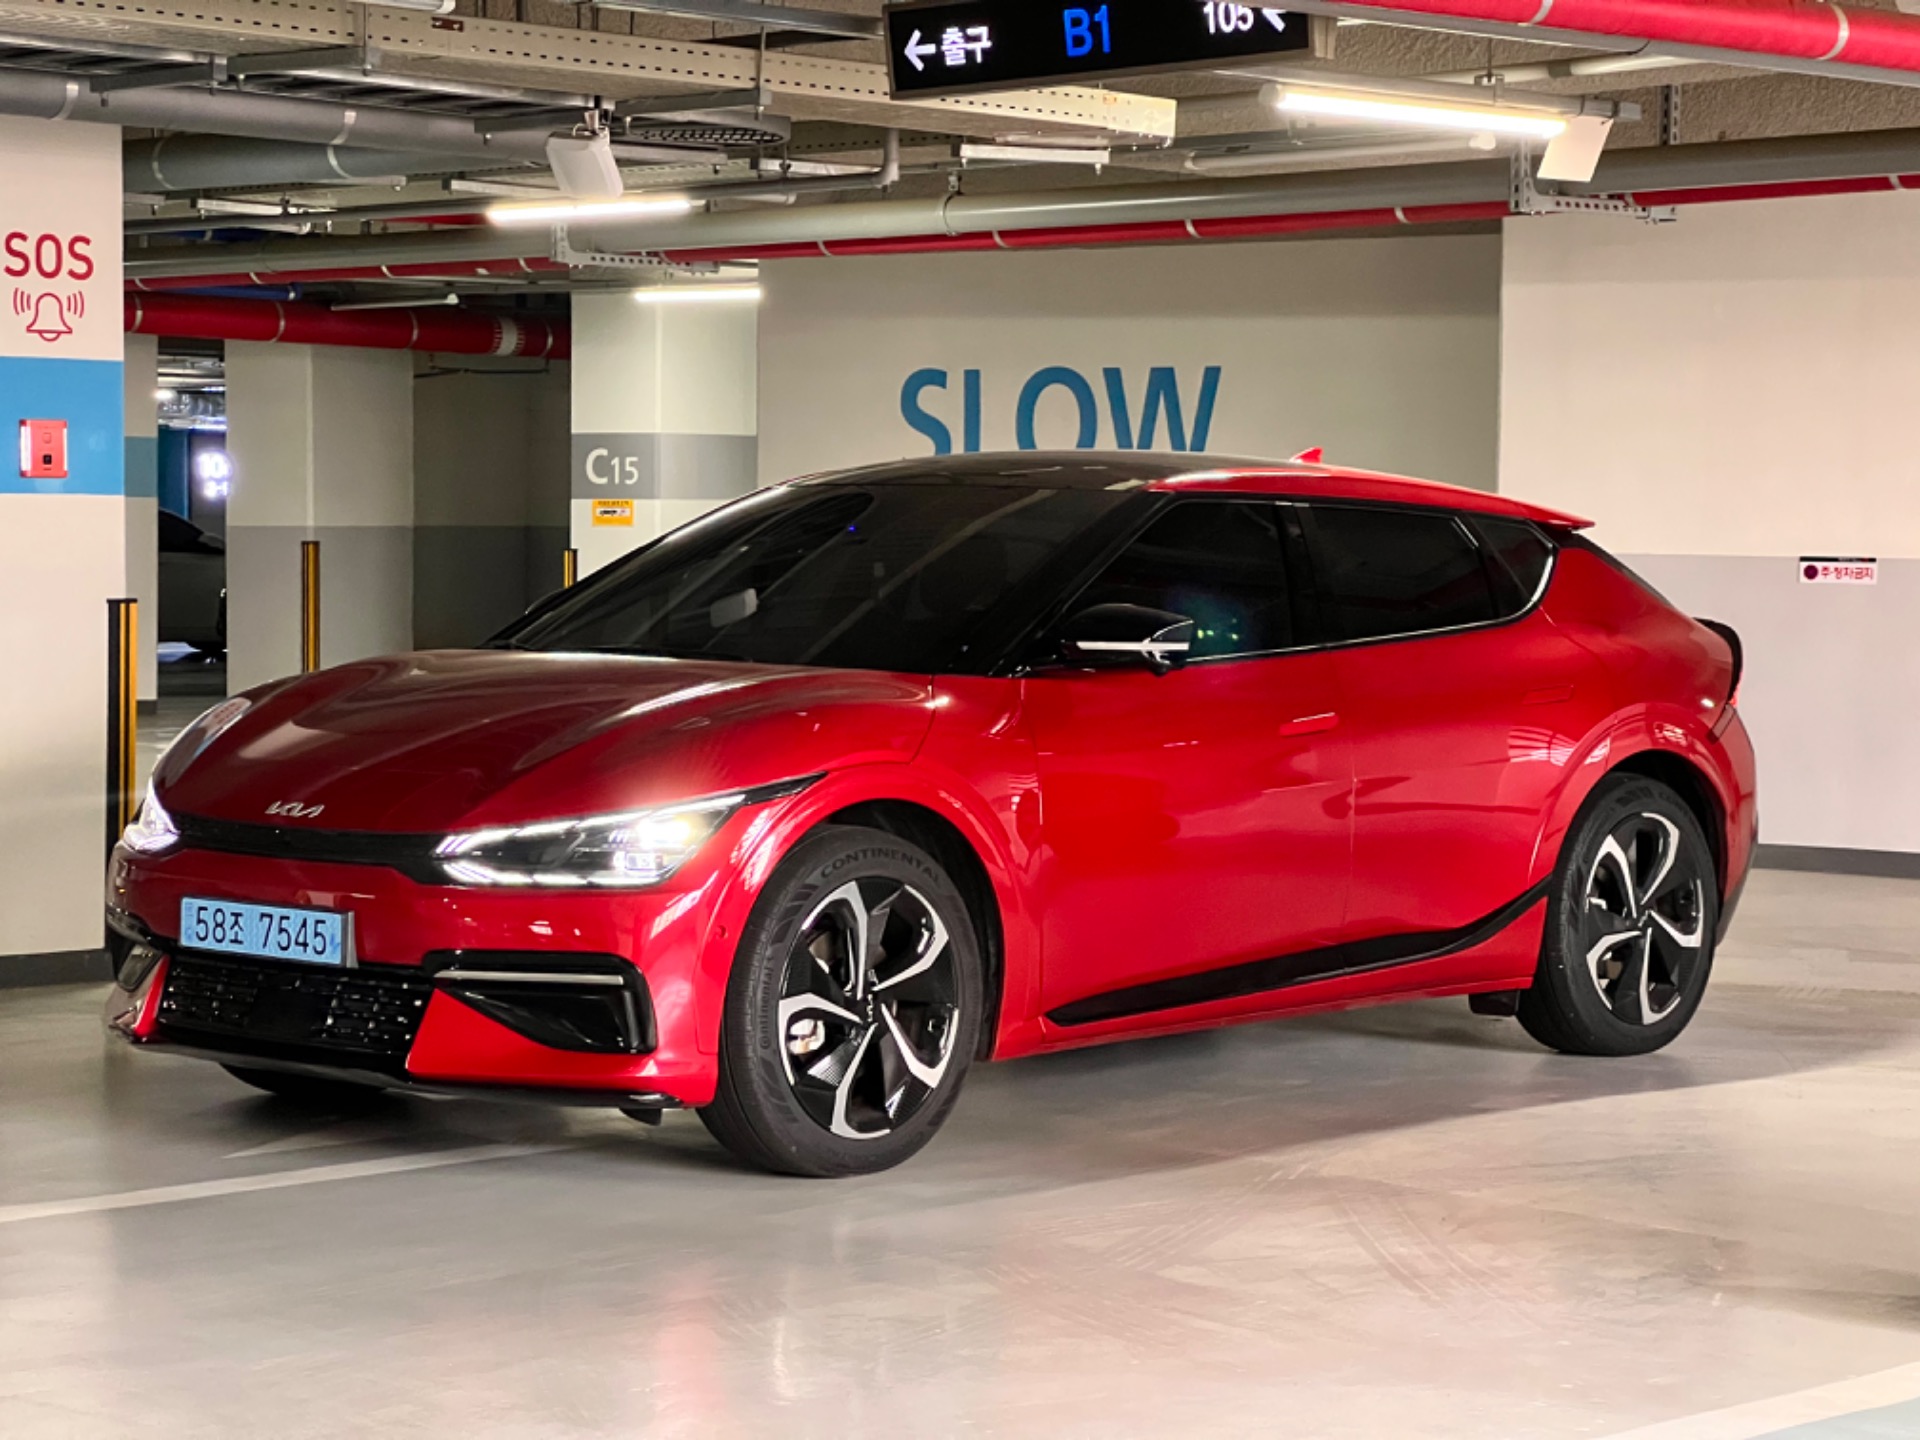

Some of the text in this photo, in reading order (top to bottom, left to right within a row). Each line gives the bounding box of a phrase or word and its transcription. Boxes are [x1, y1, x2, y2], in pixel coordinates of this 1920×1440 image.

[1063, 5, 1111, 57] B1
[1203, 1, 1255, 34] 105
[941, 26, 993, 66] 출구
[4, 231, 94, 280] SOS
[586, 447, 639, 485] C15
[820, 847, 941, 884] CONTINENTAL
[195, 905, 245, 945] 58조
[258, 912, 328, 956] 7545
